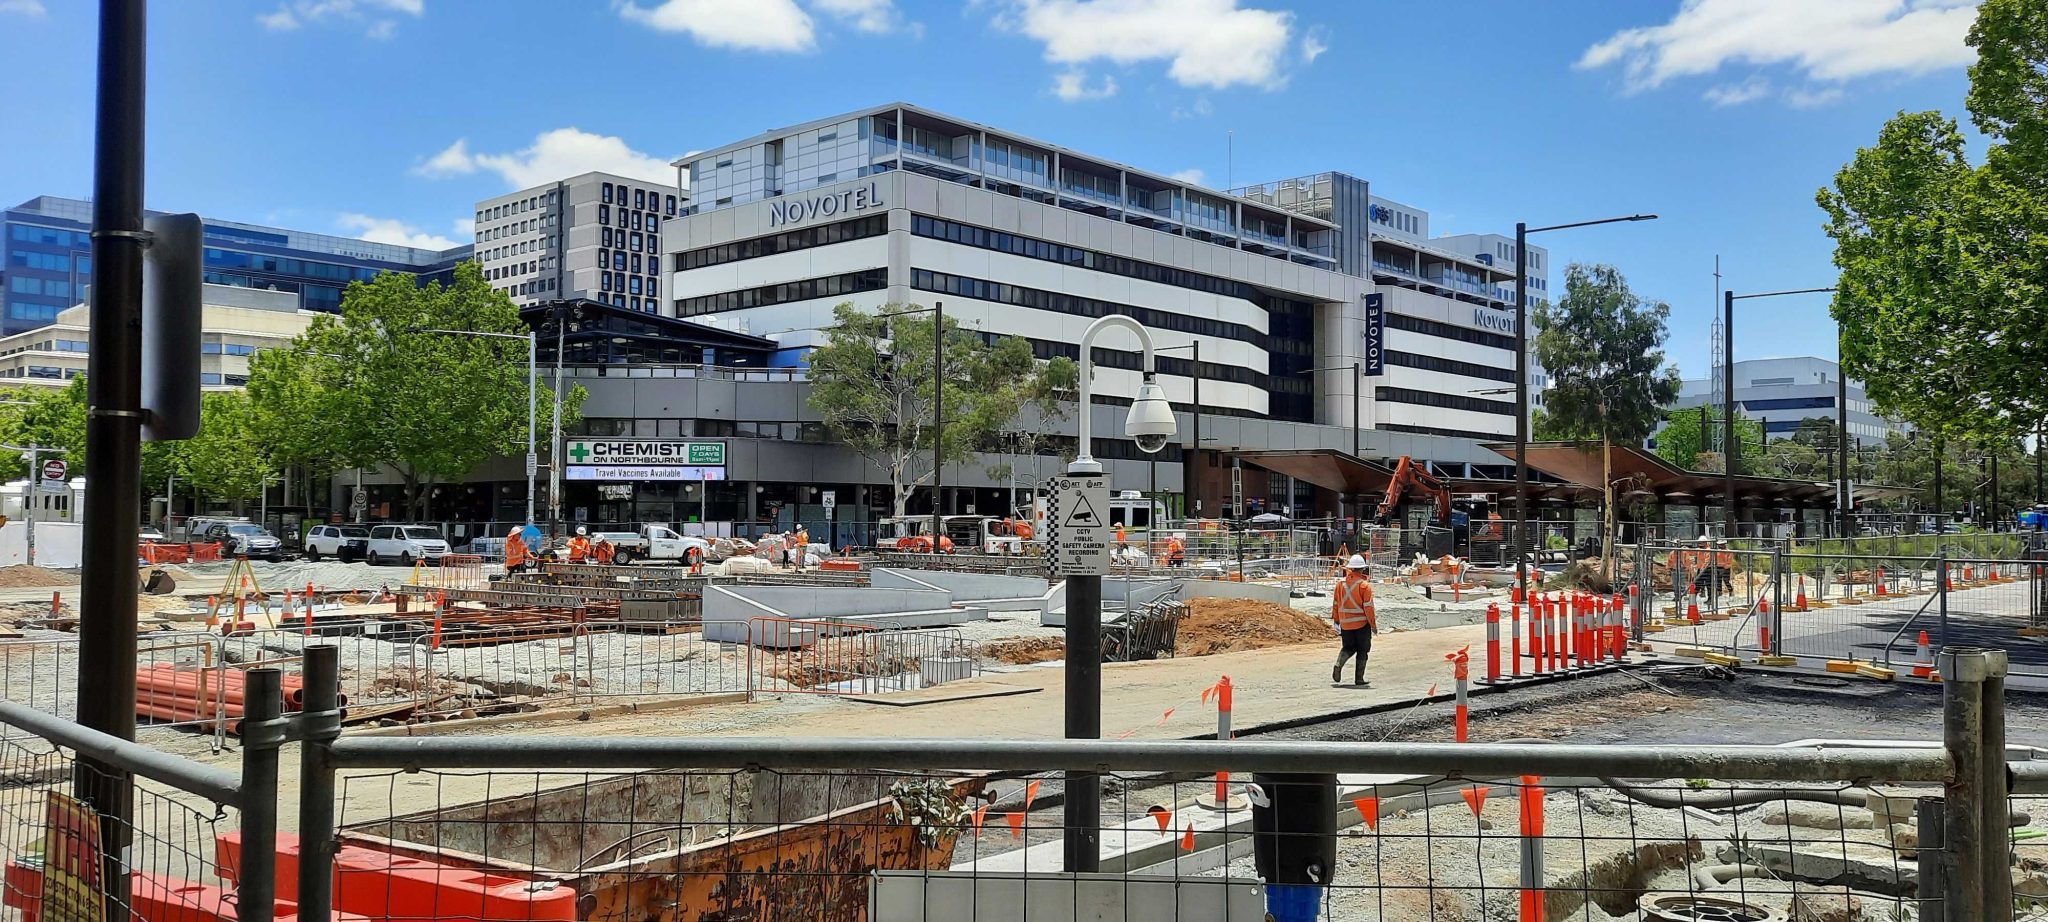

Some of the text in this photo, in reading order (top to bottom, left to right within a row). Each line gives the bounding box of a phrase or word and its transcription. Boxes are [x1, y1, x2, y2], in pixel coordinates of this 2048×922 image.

[769, 182, 884, 227] NOVOTEL
[1474, 308, 1517, 333] NOVOT
[1369, 299, 1379, 370] NOVOTEL
[593, 443, 685, 456] CHEMIST
[610, 456, 685, 464] NORTHBOURNE
[595, 468, 681, 478] Travel Vaccines Available
